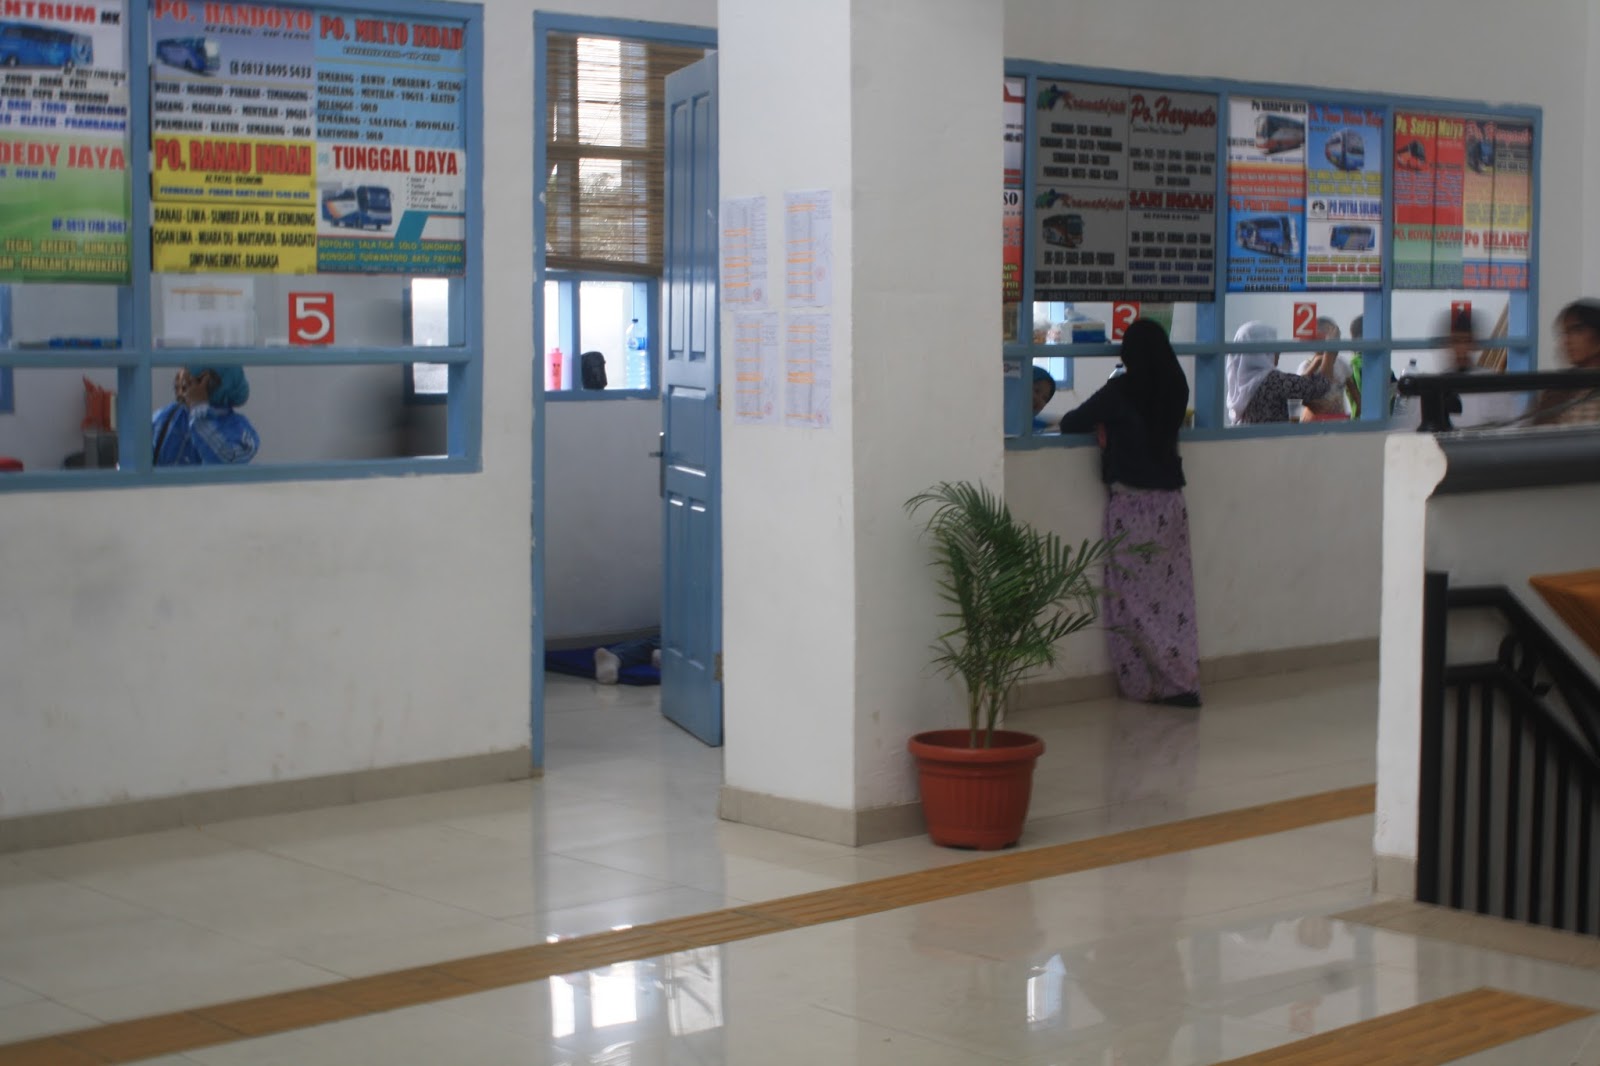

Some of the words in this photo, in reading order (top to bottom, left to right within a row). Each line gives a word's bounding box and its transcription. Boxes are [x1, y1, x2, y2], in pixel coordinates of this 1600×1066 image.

[0, 0, 96, 24] NTRUM
[101, 11, 120, 25] MK
[319, 15, 350, 42] PO.
[241, 62, 262, 77] 0812
[67, 145, 126, 172] JAYA
[153, 139, 188, 172] PO.
[255, 142, 312, 177] INDAH
[332, 145, 411, 174] TUNGGAL
[414, 149, 458, 176] DAYA
[1129, 190, 1163, 208] SARI
[295, 296, 331, 341] 5
[1114, 303, 1138, 338] 3
[1296, 304, 1315, 336] 2
